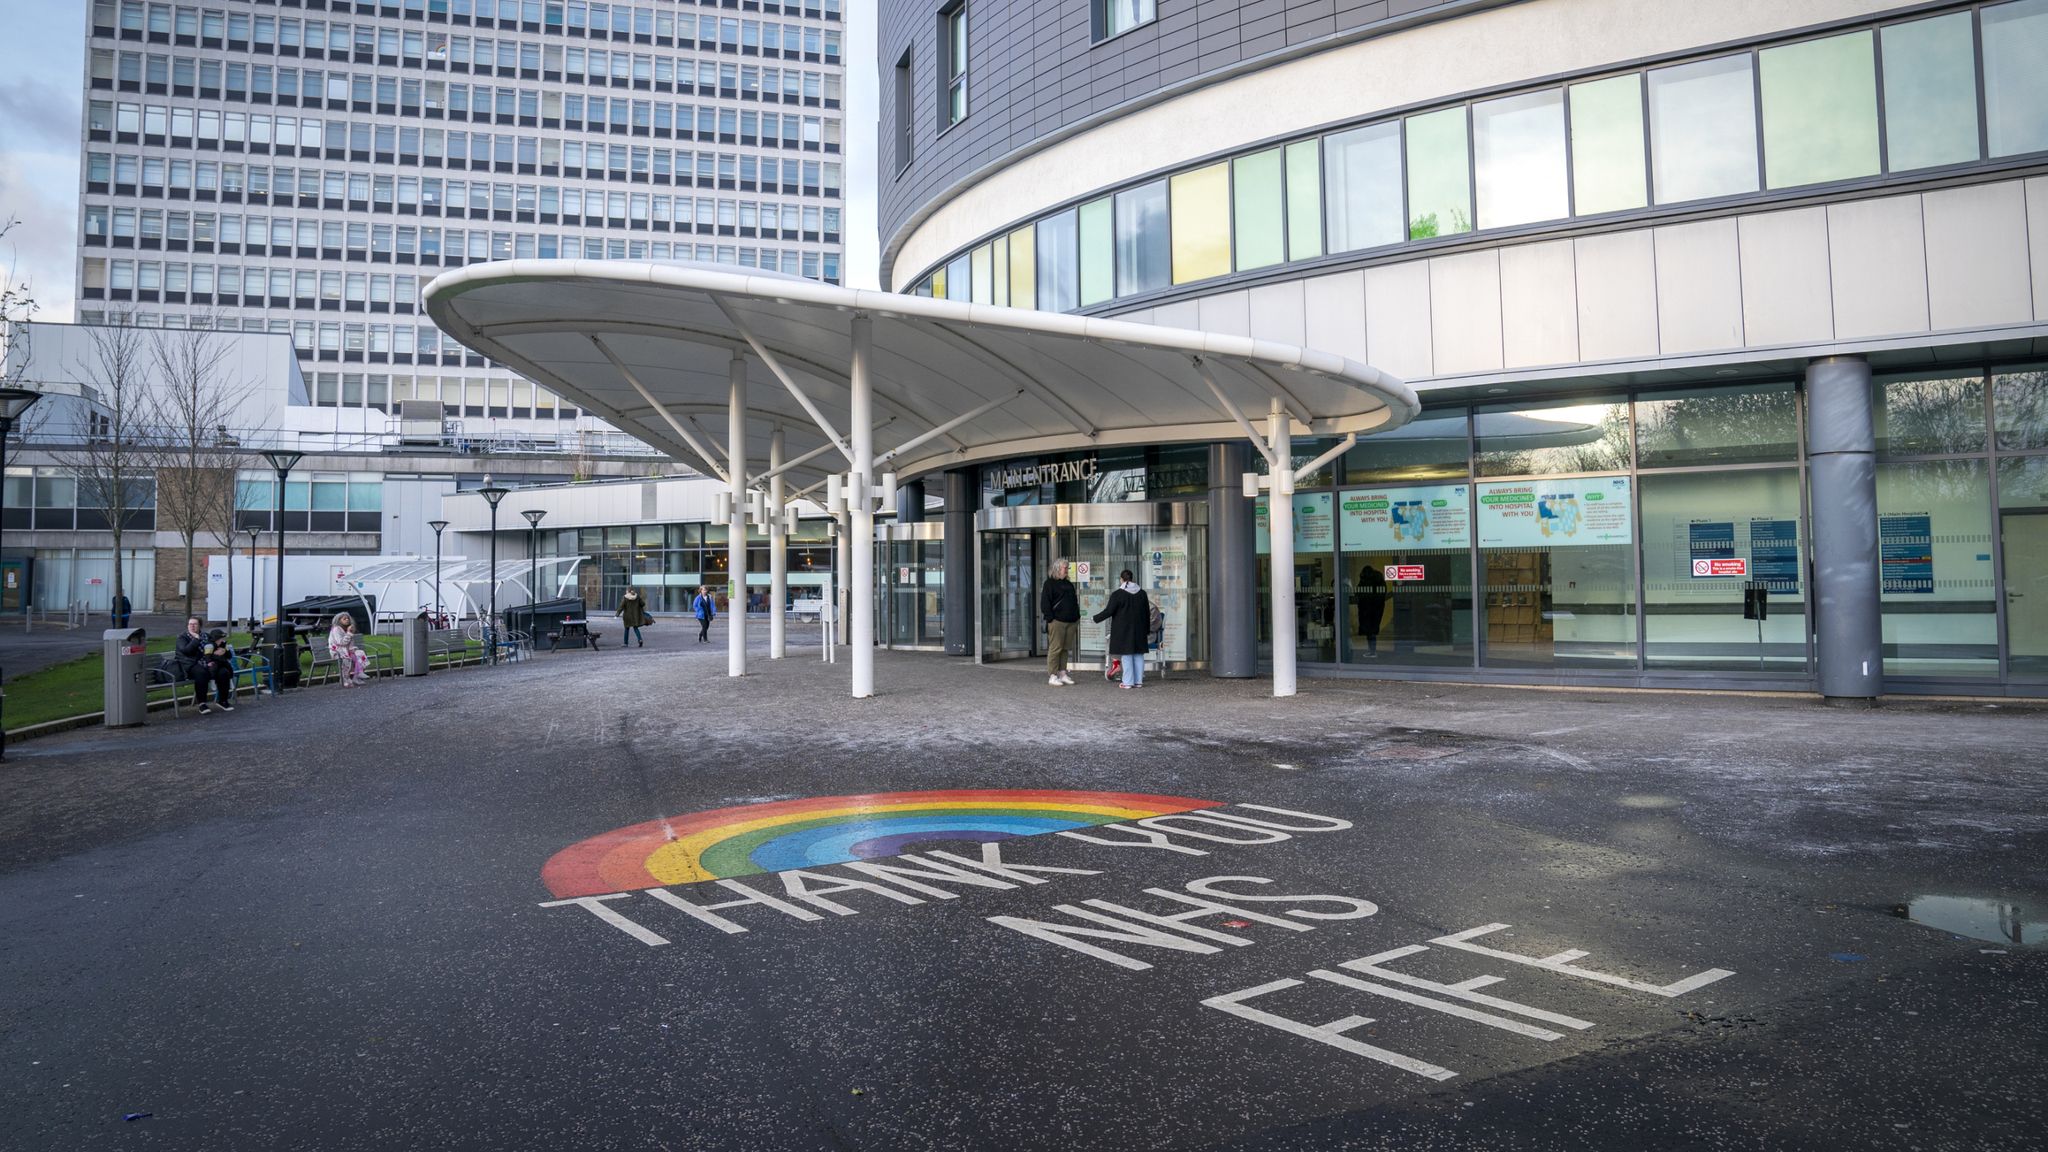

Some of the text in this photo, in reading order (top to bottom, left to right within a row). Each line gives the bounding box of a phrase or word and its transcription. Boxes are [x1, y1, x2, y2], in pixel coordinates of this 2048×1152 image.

[990, 457, 1098, 490] MAIN ENTRANCE
[1500, 494, 1534, 503] MEDICINES
[538, 802, 1353, 947] THANK YOU
[985, 875, 1379, 971] NHS
[1200, 922, 1737, 1082] FIFE
